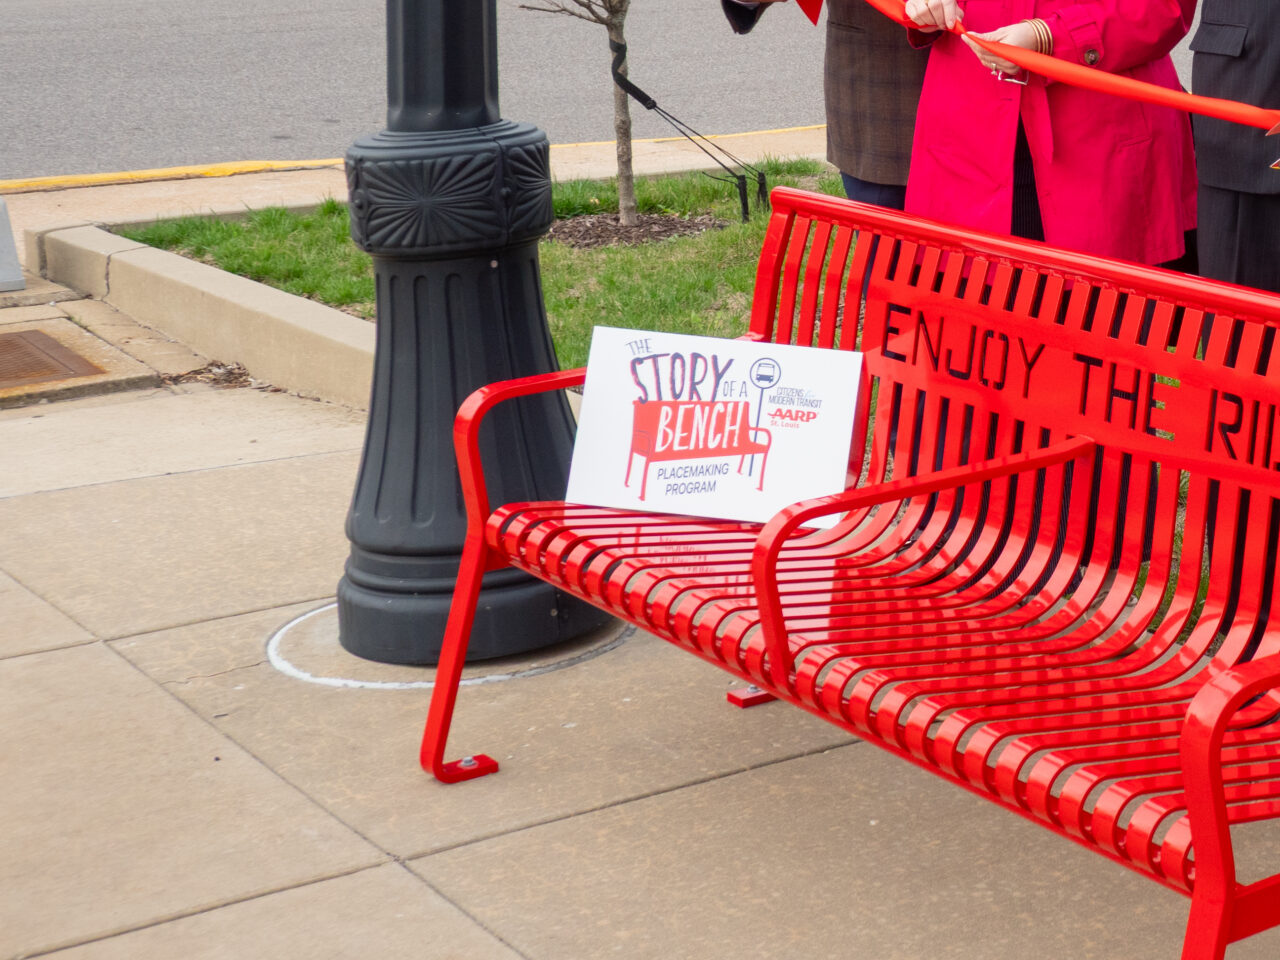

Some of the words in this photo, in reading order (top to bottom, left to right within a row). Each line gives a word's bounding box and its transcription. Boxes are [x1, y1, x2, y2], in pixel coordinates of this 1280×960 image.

[625, 338, 653, 356] THE
[630, 352, 734, 404] STORY
[723, 381, 737, 397] OF
[739, 380, 748, 398] A
[881, 302, 1046, 399] ENJOY
[1073, 352, 1181, 441] THE
[776, 387, 804, 397] CITIZENS
[768, 395, 795, 406] MODERN
[796, 398, 822, 409] TRANSIT
[767, 408, 817, 423] AARP
[655, 401, 745, 453] BENCH
[657, 462, 729, 480] PLACEMAKING
[665, 480, 716, 496] PROGRAM
